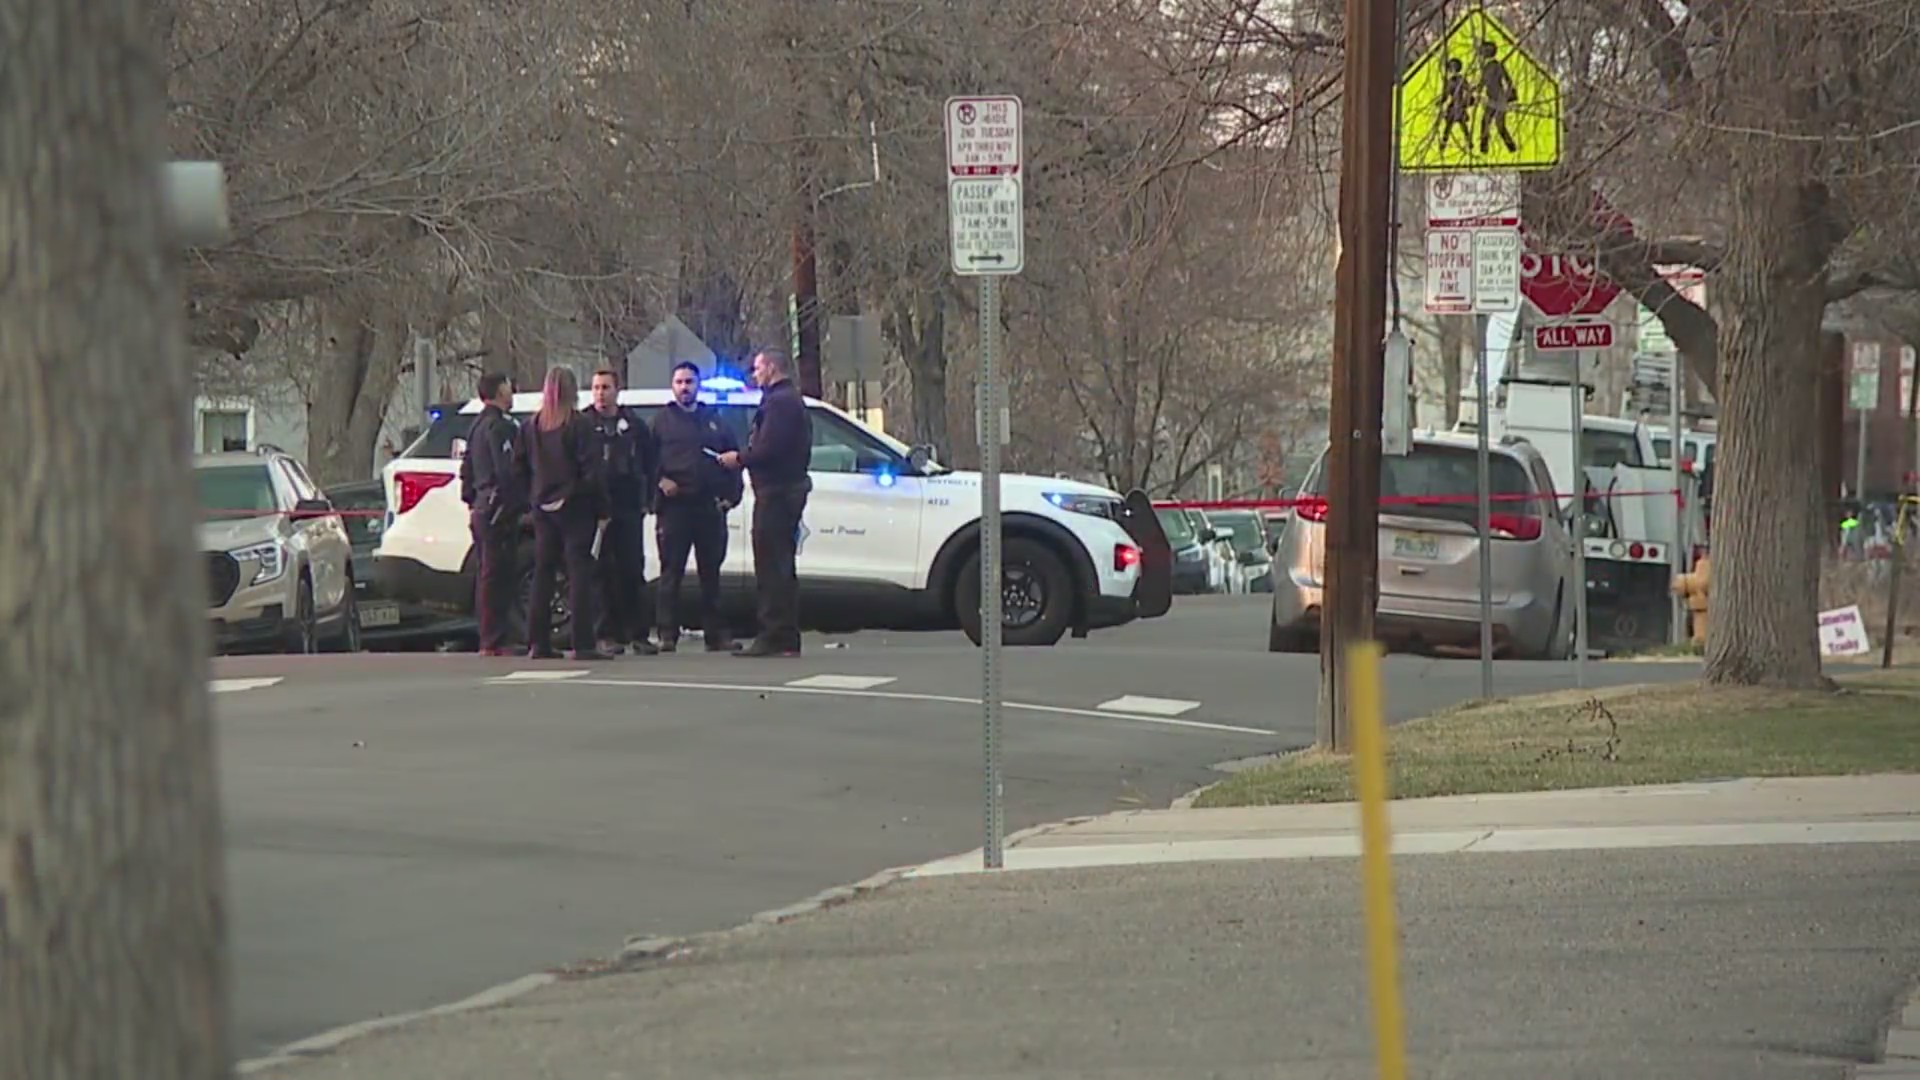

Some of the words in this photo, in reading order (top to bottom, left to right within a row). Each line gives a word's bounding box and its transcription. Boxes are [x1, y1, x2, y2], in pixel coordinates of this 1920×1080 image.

[986, 102, 1008, 113] THIS
[961, 127, 975, 139] 2ND
[981, 127, 1015, 138] TUESDAY
[957, 142, 972, 152] APR
[974, 142, 994, 152] THRU
[996, 142, 1012, 152] NOV
[993, 200, 1015, 214] ONLY
[1440, 234, 1459, 251] NO
[1427, 251, 1472, 270] STOPPING
[1440, 269, 1459, 281] ANY
[1439, 280, 1459, 294] TIME
[1542, 327, 1570, 346] ALL
[1575, 326, 1606, 345] WAY
